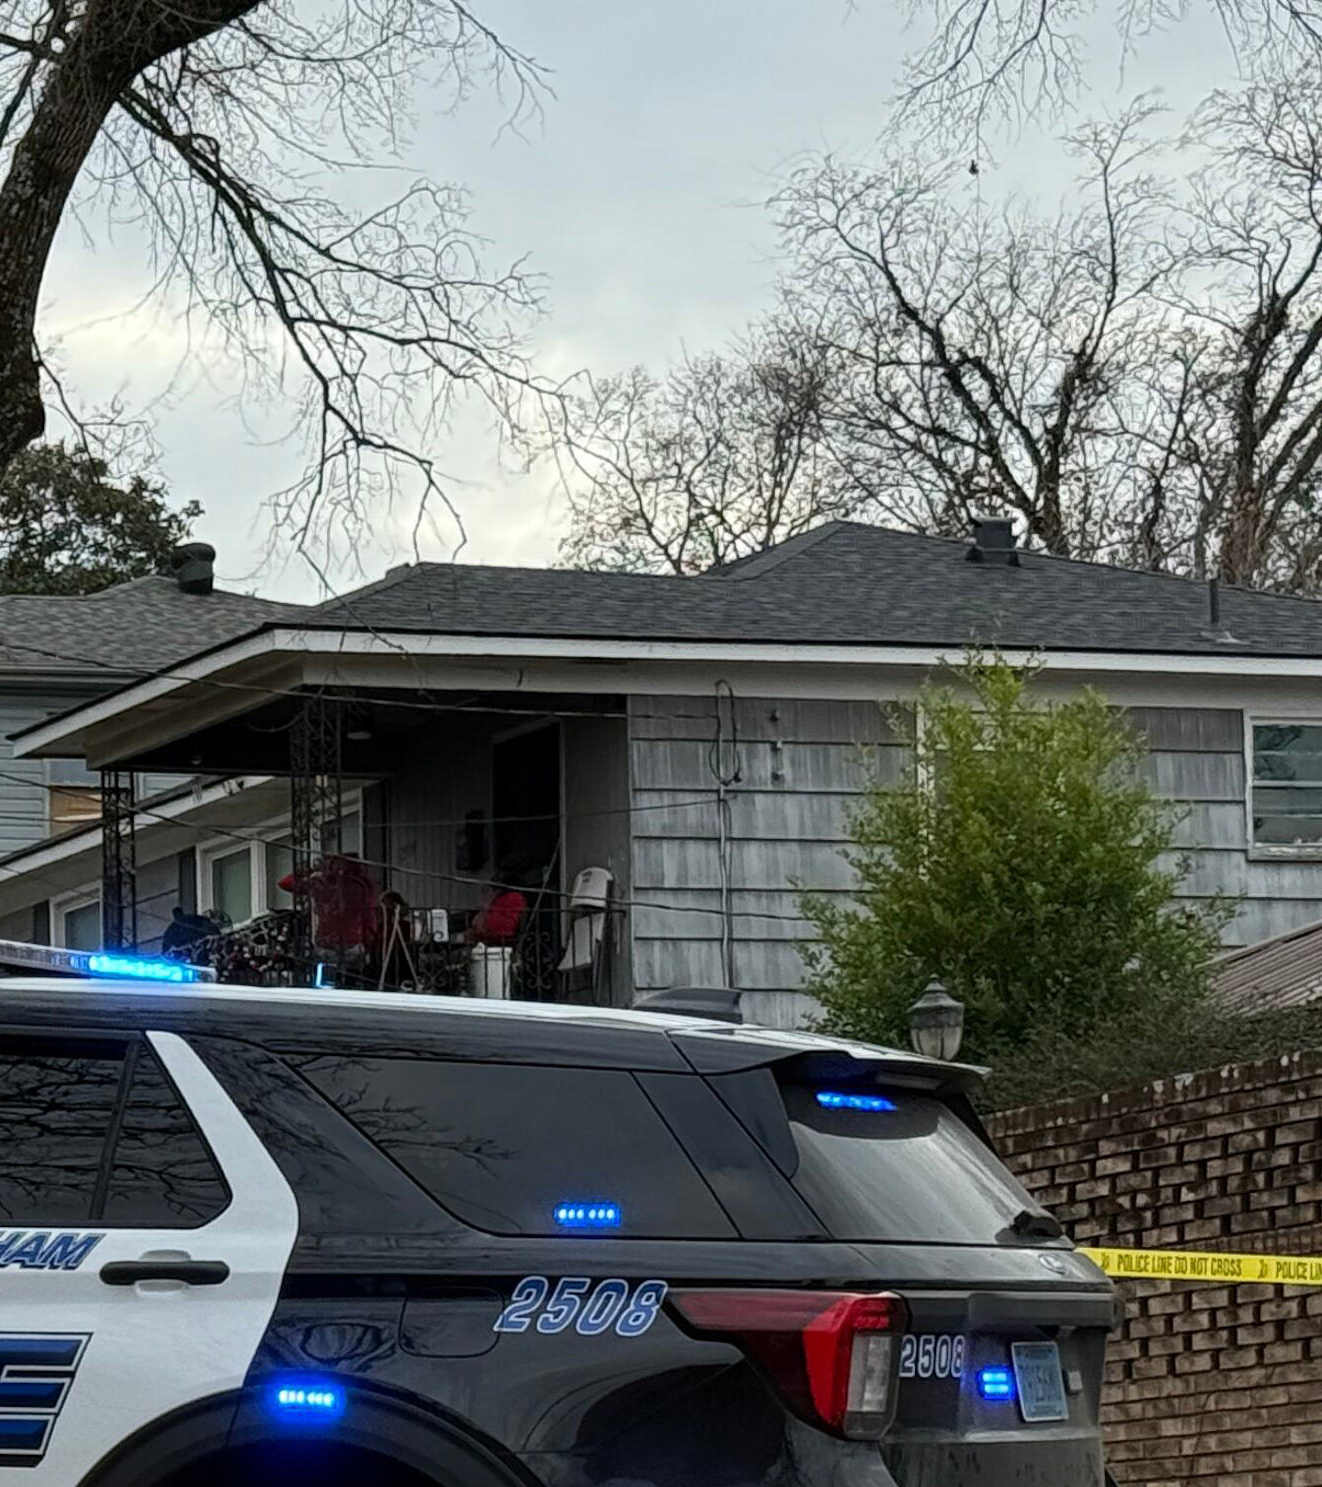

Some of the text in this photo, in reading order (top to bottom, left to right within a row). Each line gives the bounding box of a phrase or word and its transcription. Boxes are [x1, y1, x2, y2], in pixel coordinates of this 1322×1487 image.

[1117, 1255, 1242, 1277] POLICE LINE DO NOT CROSS
[1275, 1261, 1307, 1279] POLICE
[493, 1276, 669, 1337] 2508
[898, 1334, 966, 1379] 2508
